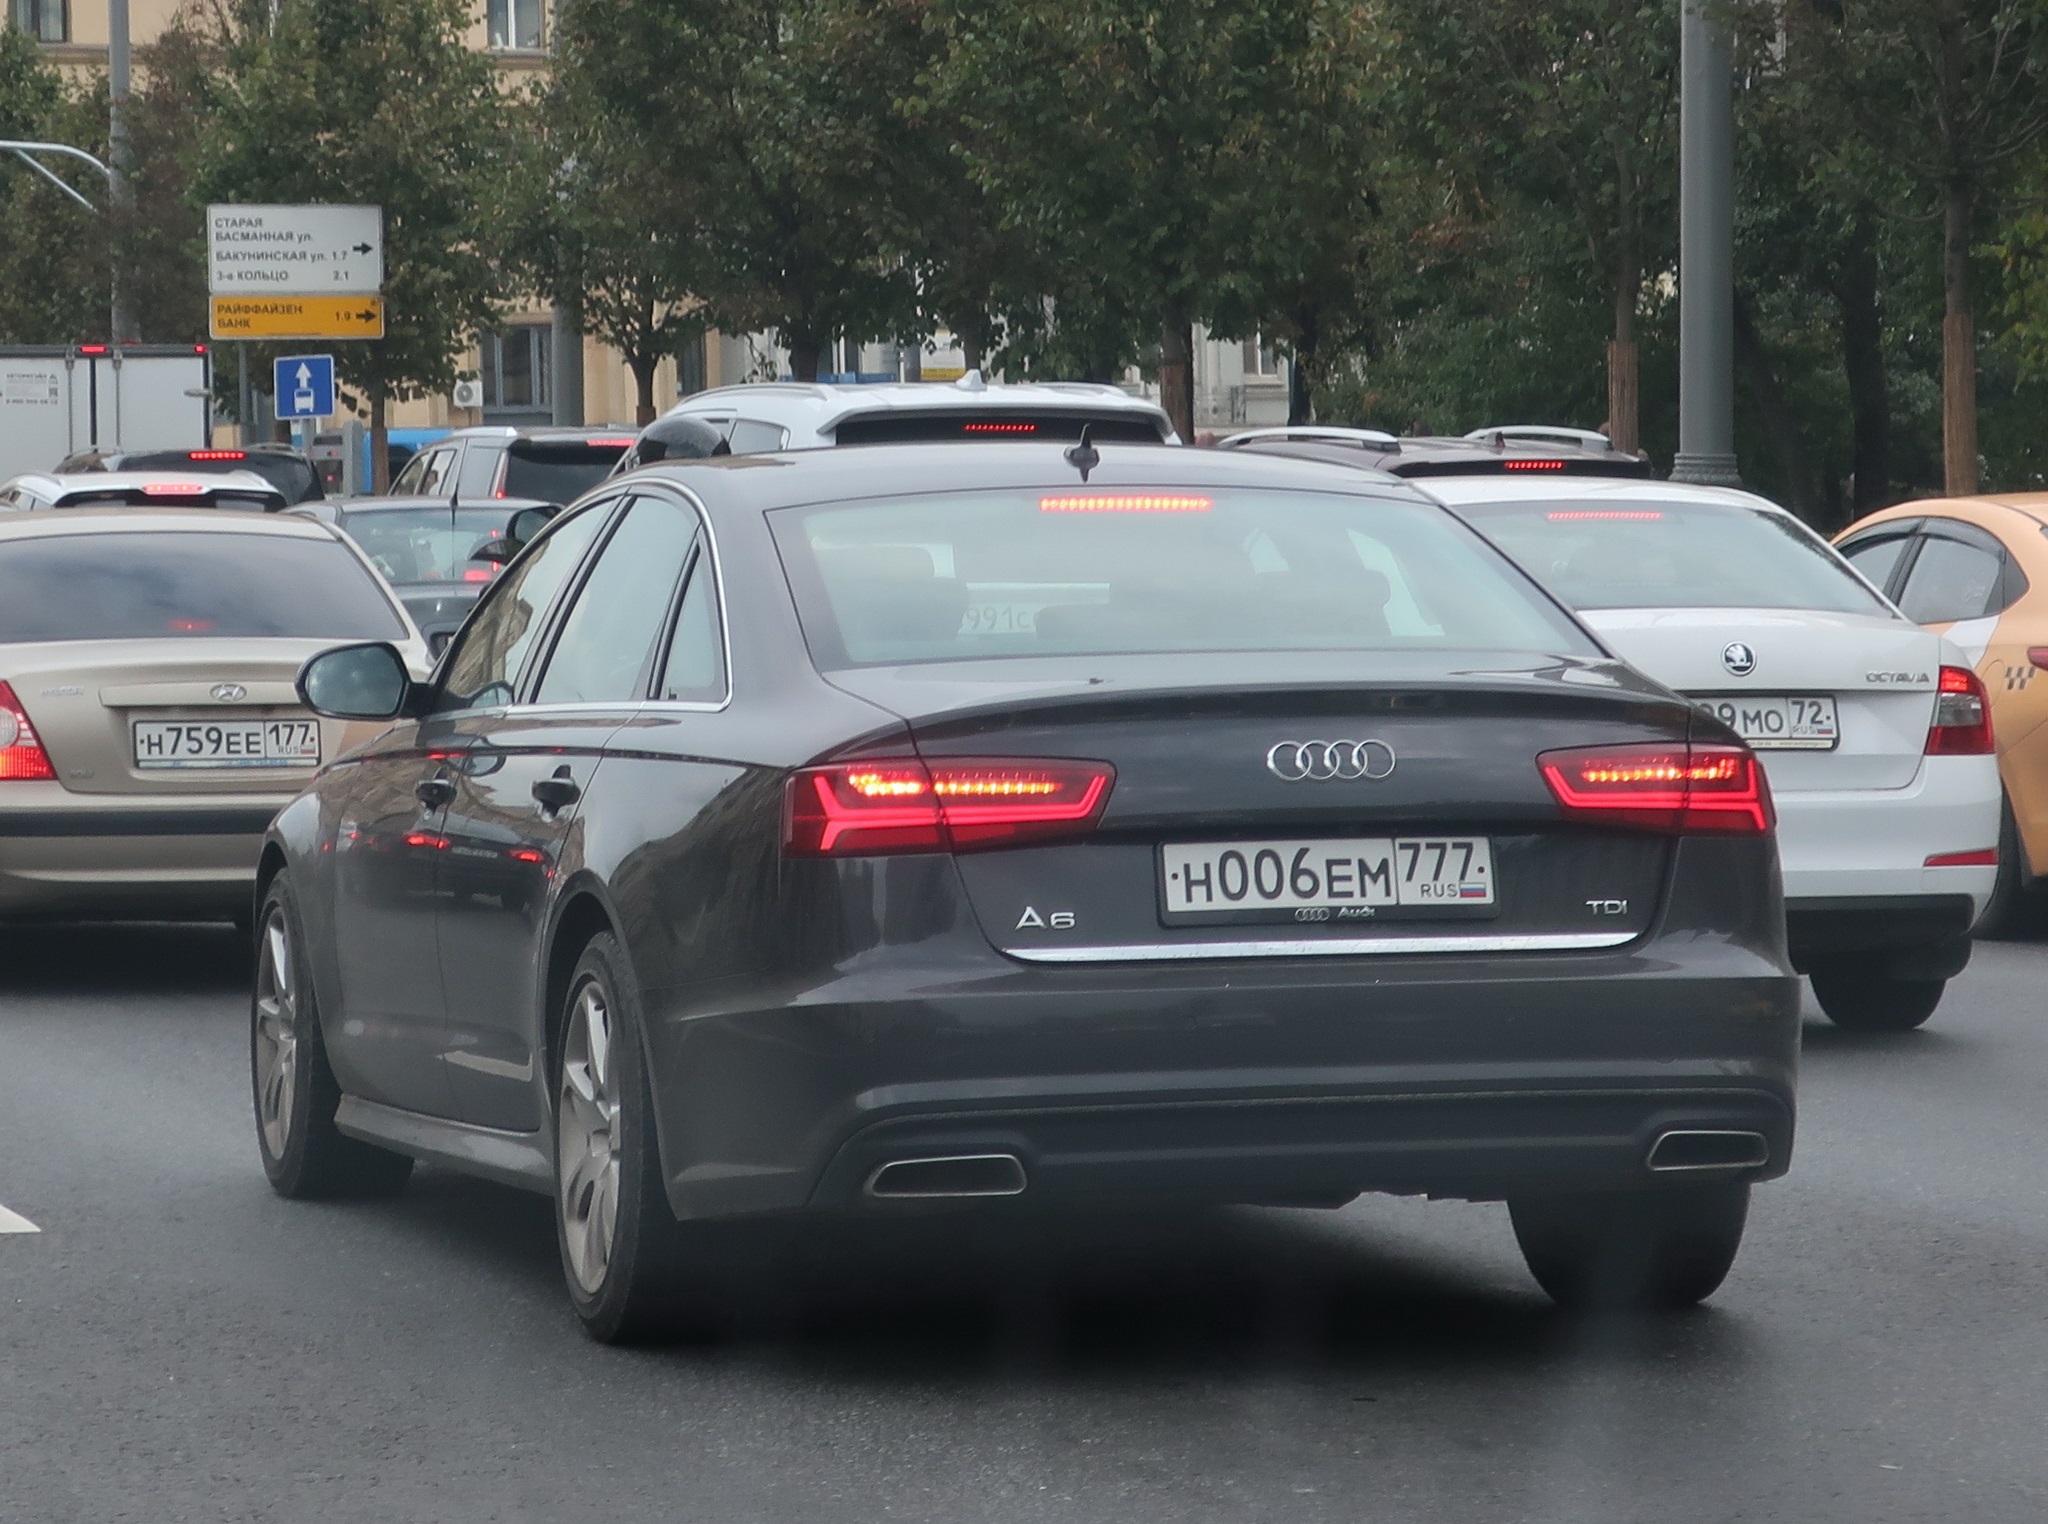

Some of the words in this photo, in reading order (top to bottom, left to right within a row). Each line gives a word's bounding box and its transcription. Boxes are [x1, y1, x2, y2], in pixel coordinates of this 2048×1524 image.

[214, 217, 262, 228] СТАРАЯ
[215, 231, 293, 242] БАСМАННАЯ
[216, 251, 307, 261] БАКУНИНСКАЯ
[332, 250, 347, 261] 1.7
[236, 270, 289, 283] КОЛЬЦО
[333, 269, 349, 281] 2.1
[217, 302, 303, 314] РАЙФФАЙЗЕН
[217, 318, 251, 329] БАНК
[1865, 671, 1930, 683] OCTAVIA
[1790, 700, 1824, 725] 72
[268, 723, 310, 746] 177
[278, 746, 300, 754] RUS
[1398, 841, 1474, 883] 777
[1420, 883, 1458, 898] RUS
[1337, 905, 1376, 918] Audi
[1585, 899, 1628, 915] TDI
[1014, 905, 1076, 931] A6
